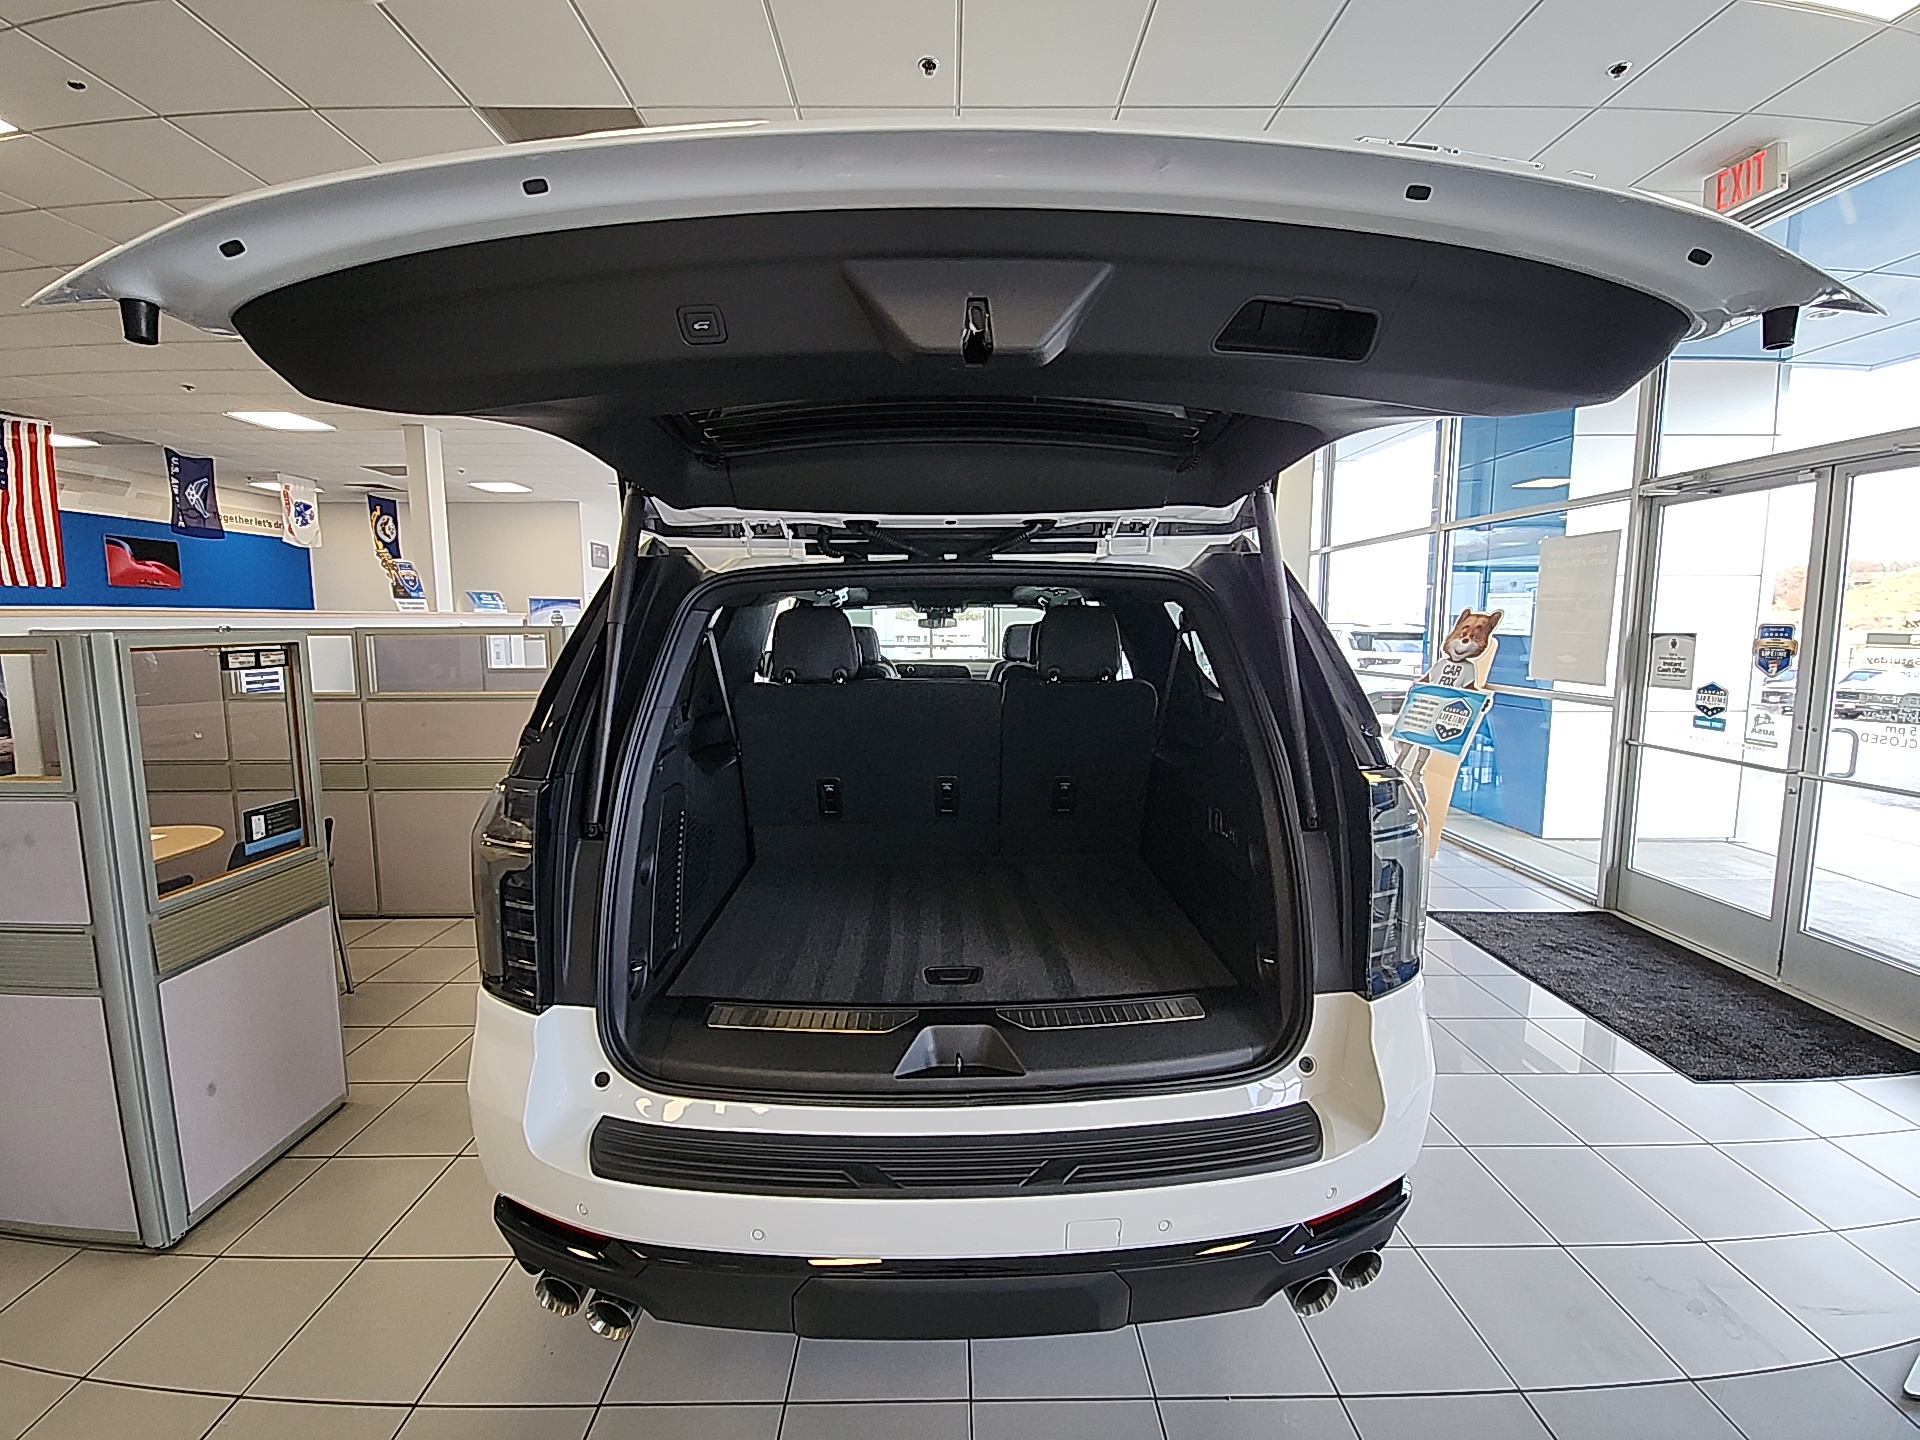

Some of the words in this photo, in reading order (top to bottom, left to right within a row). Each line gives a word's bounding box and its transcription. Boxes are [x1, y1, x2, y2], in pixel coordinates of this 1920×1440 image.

[1717, 150, 1767, 211] EXIT
[219, 514, 253, 525] ogether
[255, 517, 273, 528] let's
[1443, 664, 1463, 677] CAR
[1438, 675, 1458, 687] FOX
[1696, 695, 1727, 705] LIFETIME
[1439, 713, 1467, 725] LIFETIME
